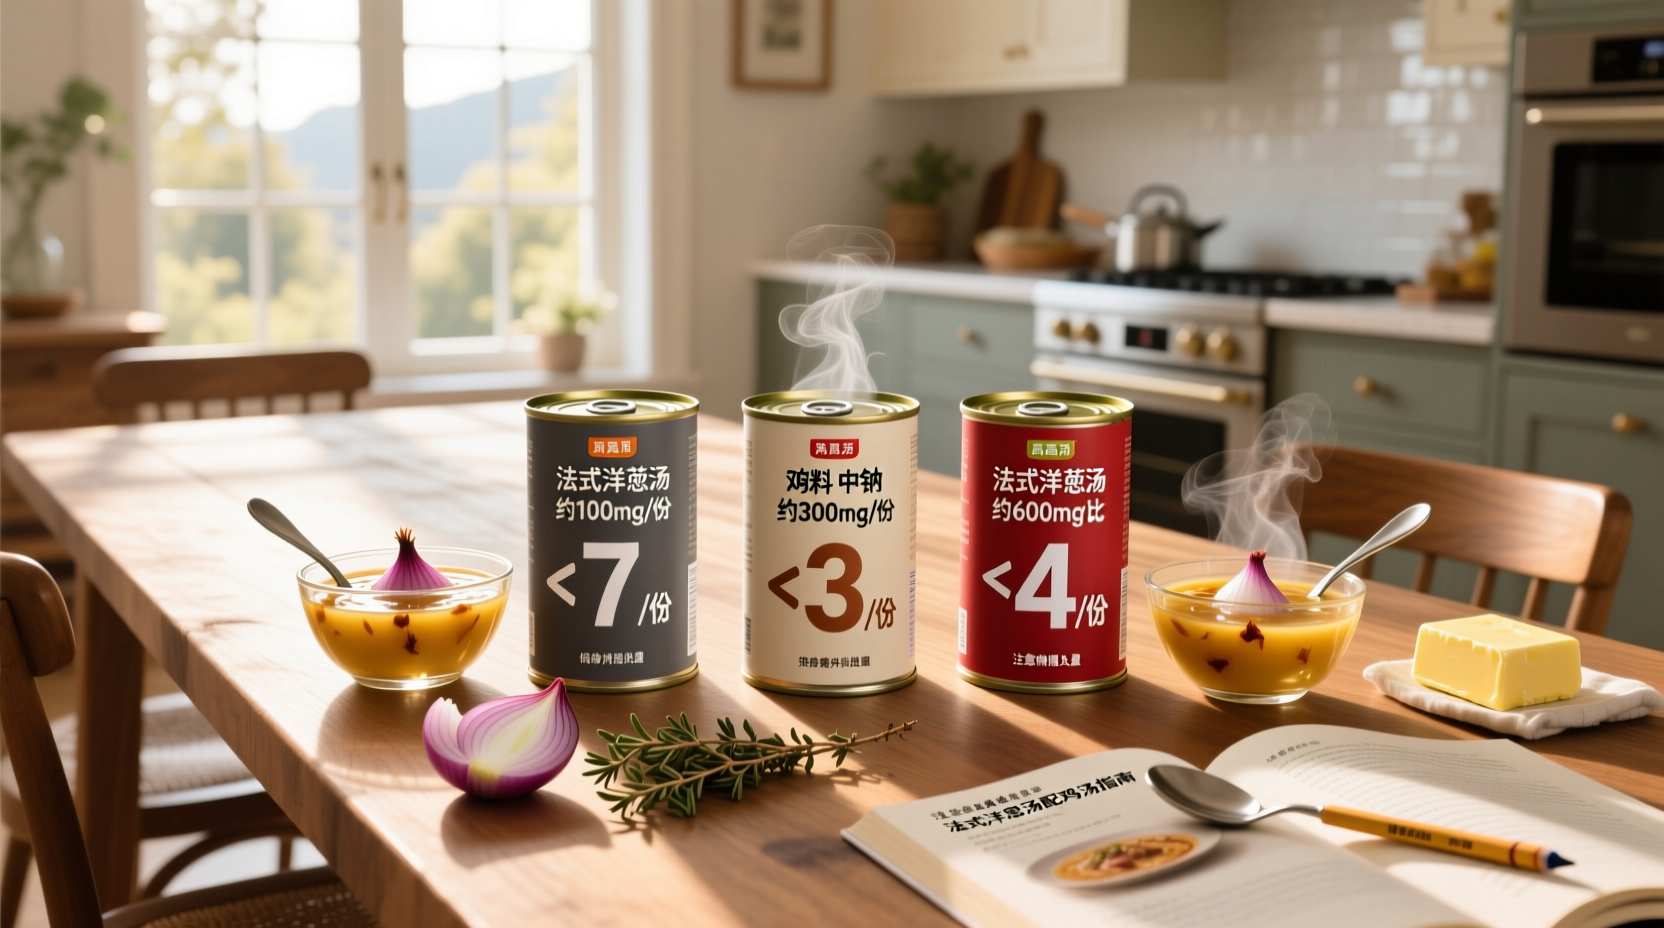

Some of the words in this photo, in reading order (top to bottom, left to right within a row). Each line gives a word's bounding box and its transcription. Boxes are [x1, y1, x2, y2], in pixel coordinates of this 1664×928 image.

[838, 467, 883, 494] 中钠
[556, 496, 672, 526] 约100mg/份
[777, 498, 895, 528] 约300mg/份
[992, 498, 1105, 527] 约600mg比
